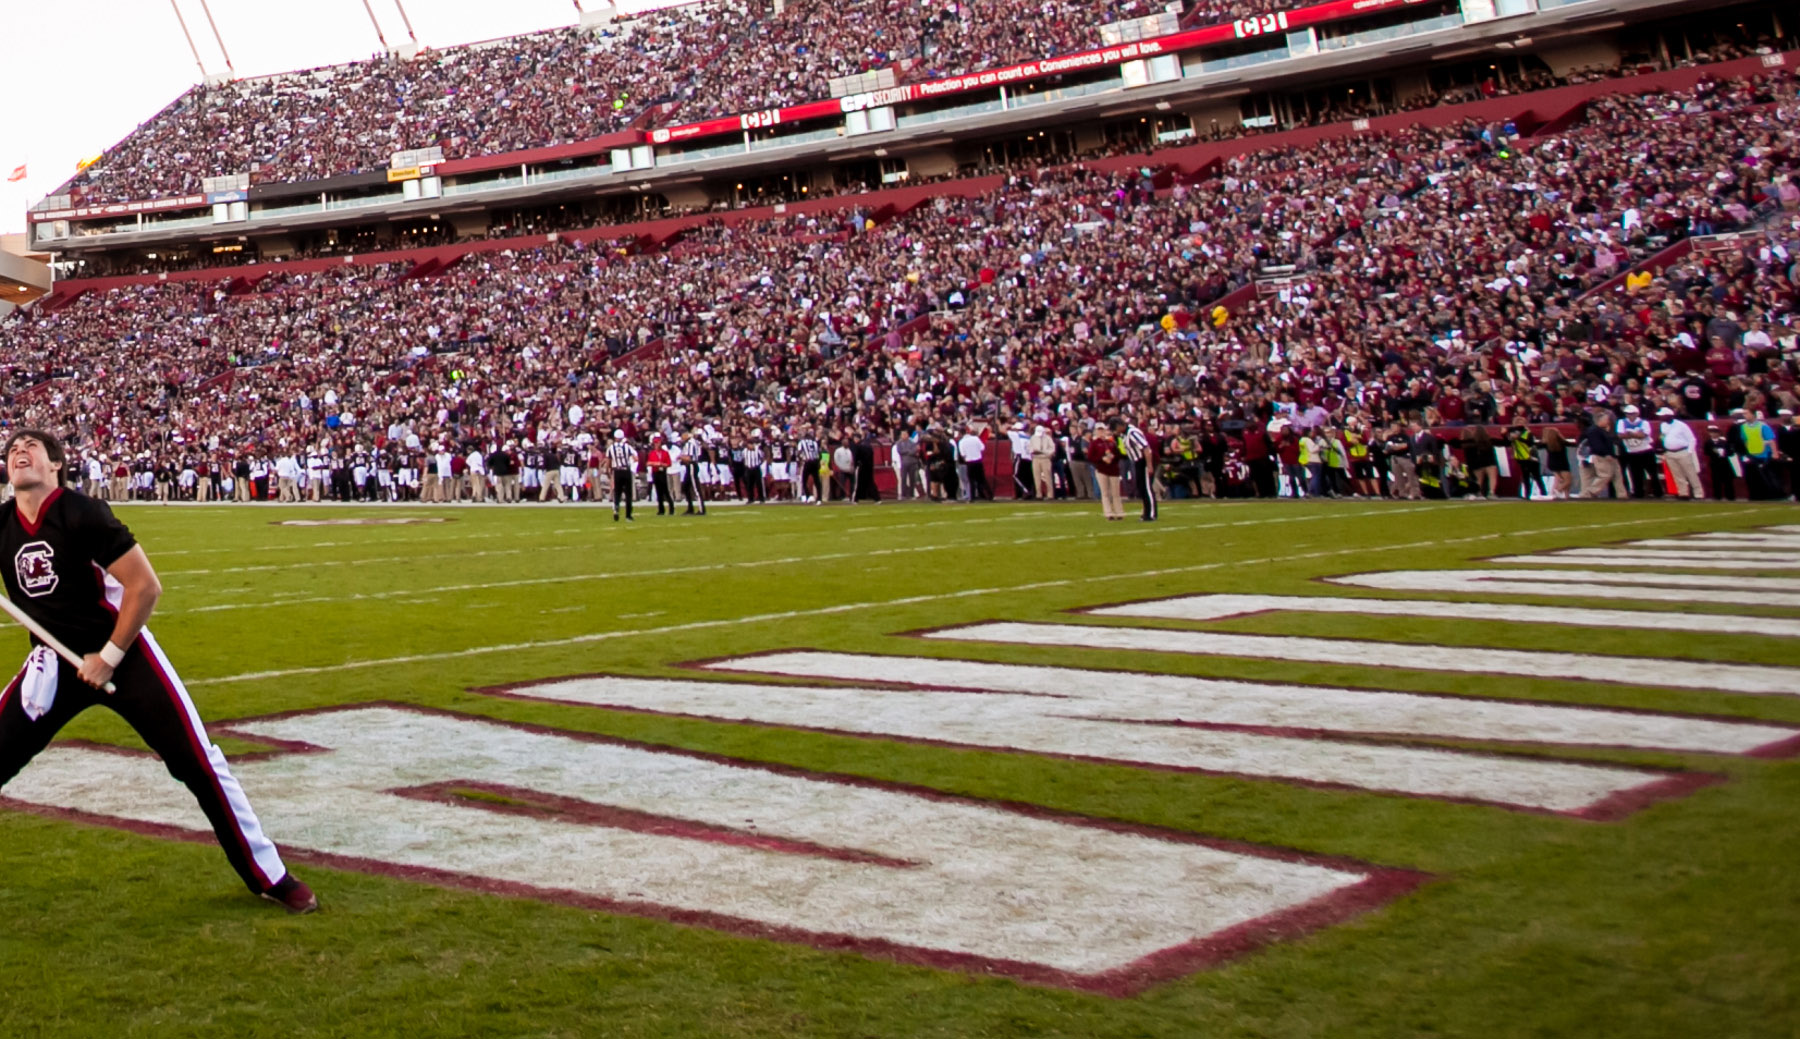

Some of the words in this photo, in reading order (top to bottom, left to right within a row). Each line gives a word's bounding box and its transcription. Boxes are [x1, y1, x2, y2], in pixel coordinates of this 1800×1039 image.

[1234, 12, 1288, 38] CPI
[840, 93, 874, 112] CPI
[874, 86, 912, 107] SECURITY
[920, 78, 962, 94] Protection
[963, 76, 979, 90] you
[980, 73, 997, 85] can
[997, 67, 1023, 81] count
[1024, 65, 1040, 76] on.
[1040, 51, 1102, 73] Conveniences
[1102, 48, 1120, 63] you
[1121, 44, 1138, 58] will
[1139, 41, 1163, 55] love.
[741, 109, 780, 129] CPI
